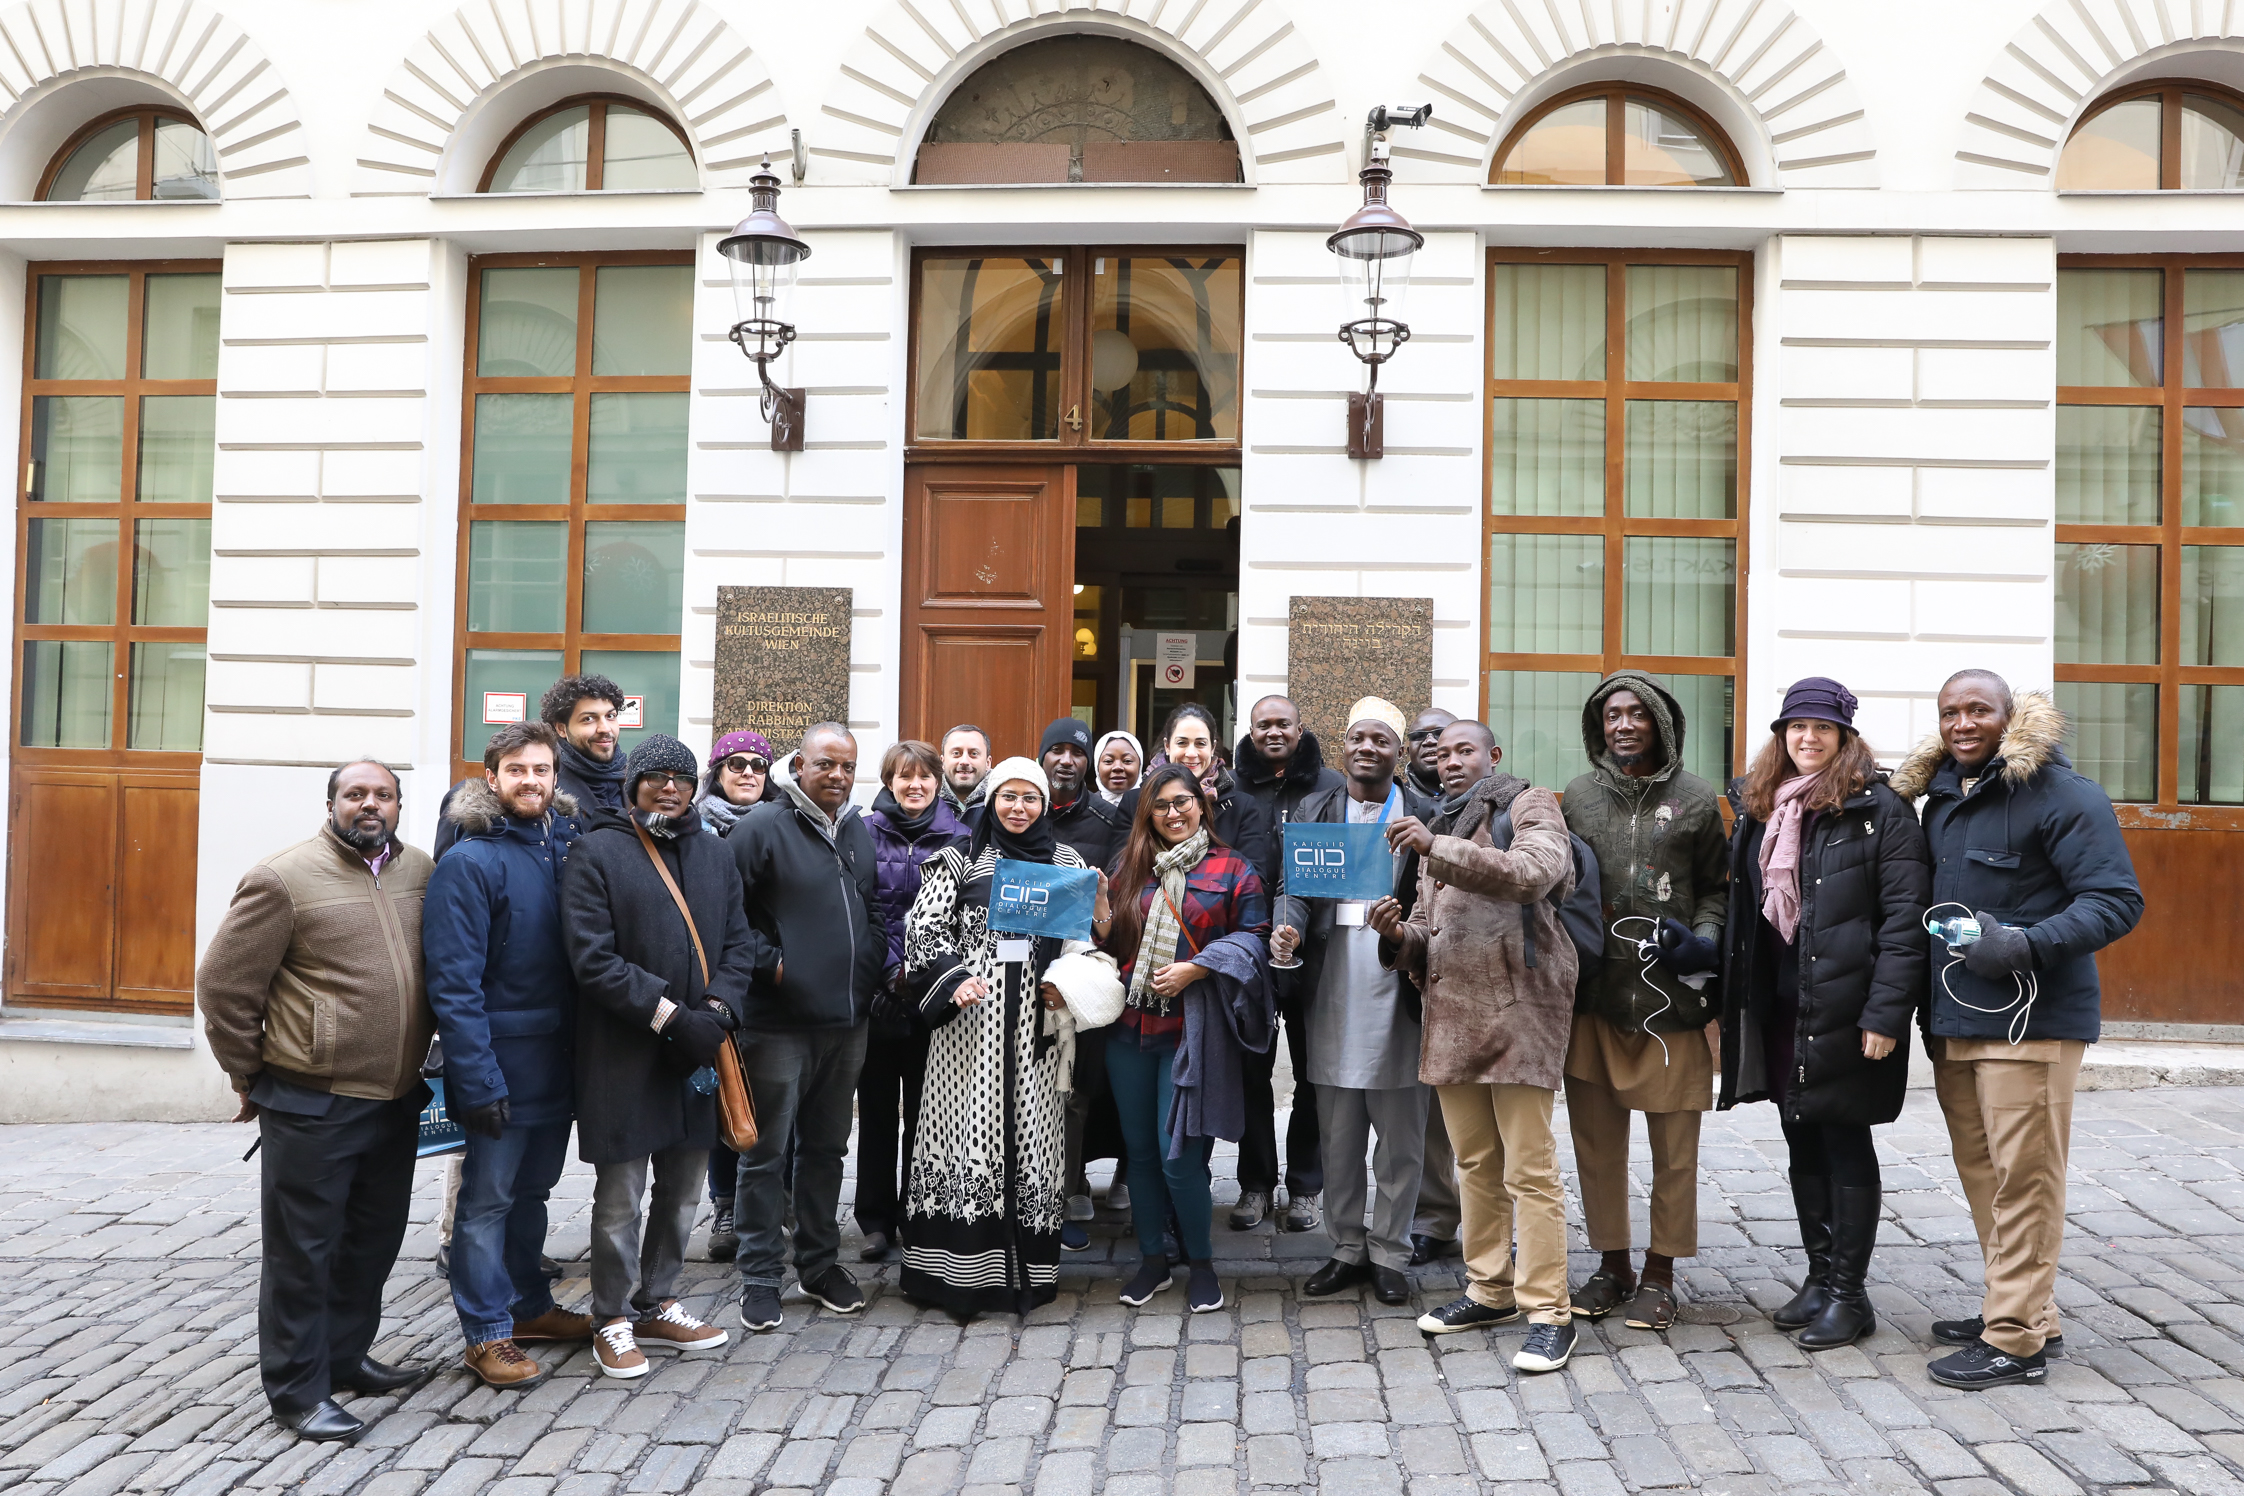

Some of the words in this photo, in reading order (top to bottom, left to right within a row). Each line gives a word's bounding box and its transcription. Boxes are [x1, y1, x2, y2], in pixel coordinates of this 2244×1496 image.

[1064, 404, 1083, 431] 4
[737, 612, 828, 624] ISRAELITISCHE
[725, 625, 840, 638] KULTUSGEMEINDE
[765, 639, 799, 650] WIEN
[747, 700, 813, 713] DIREKTION
[748, 714, 811, 726] RABBINAT
[1295, 866, 1346, 874] DIALOGUE
[1295, 872, 1347, 880] CENTRE
[1001, 876, 1051, 888] KAICIID
[997, 907, 1047, 918] CENTRE
[998, 901, 1048, 913] DIALOGUE
[418, 1126, 458, 1137] ENTRE
[420, 1122, 457, 1132] IALOGUE
